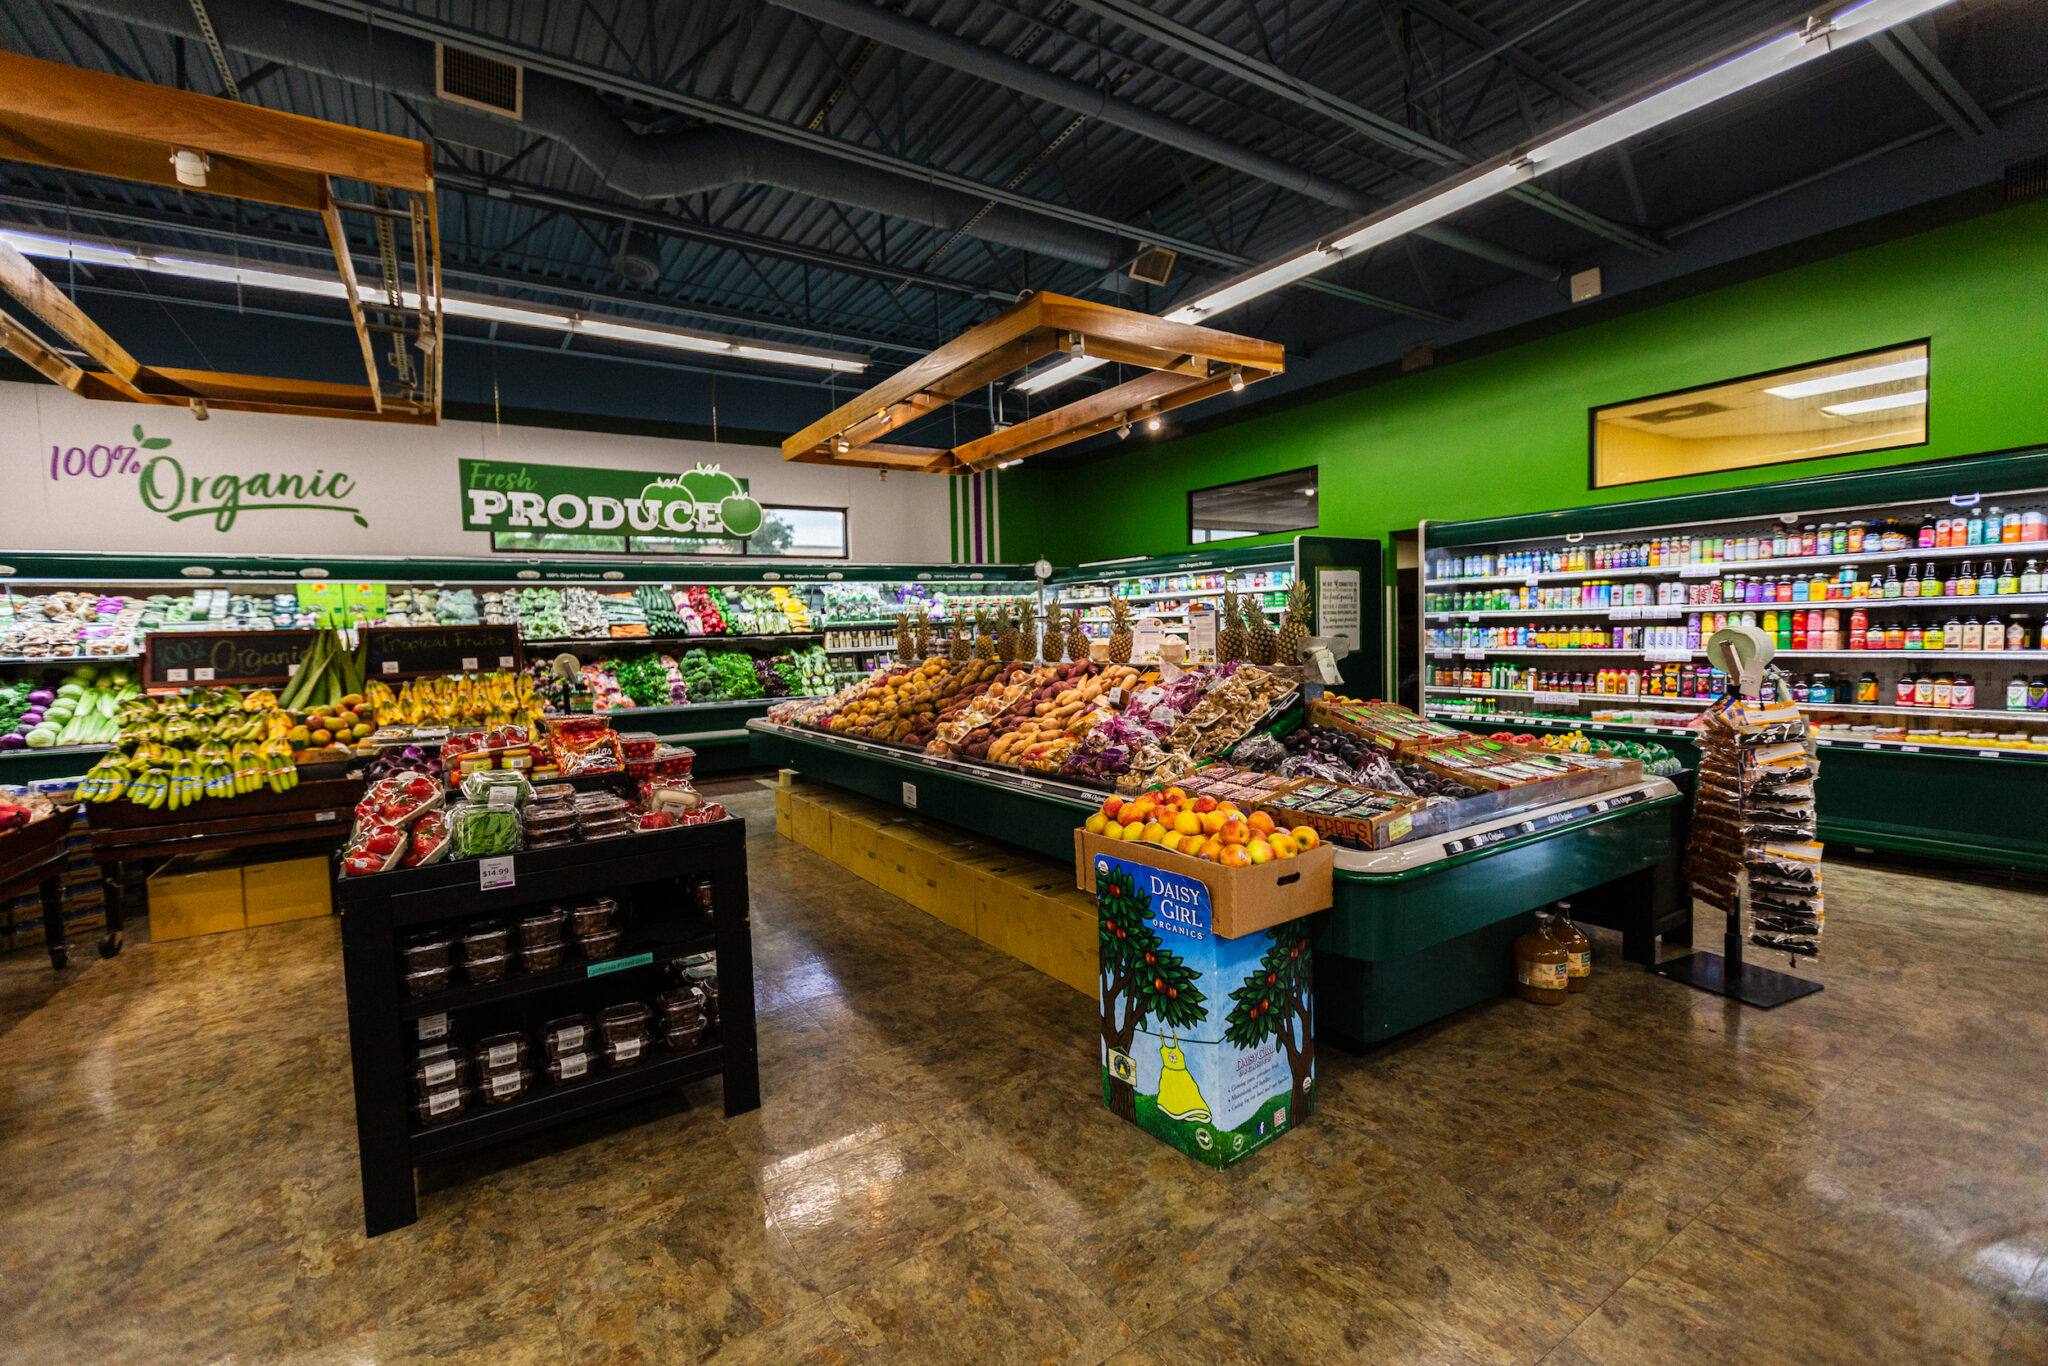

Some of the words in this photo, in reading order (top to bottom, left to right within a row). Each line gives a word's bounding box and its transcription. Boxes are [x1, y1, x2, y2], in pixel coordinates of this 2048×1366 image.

[51, 444, 141, 480] 100%
[139, 455, 357, 533] Organic
[469, 462, 539, 491] Fresh
[467, 489, 724, 534] PRODUCE
[376, 633, 448, 653] Tropical
[453, 631, 506, 649] Fruits
[1306, 815, 1369, 840] BERRIES
[481, 867, 510, 878] $14.99
[1149, 875, 1201, 906] DAISY
[1160, 898, 1204, 928] GIRL
[1152, 918, 1204, 940] ORGANICS
[1235, 1053, 1259, 1072] DAISY
[1257, 1043, 1275, 1061] GIRL
